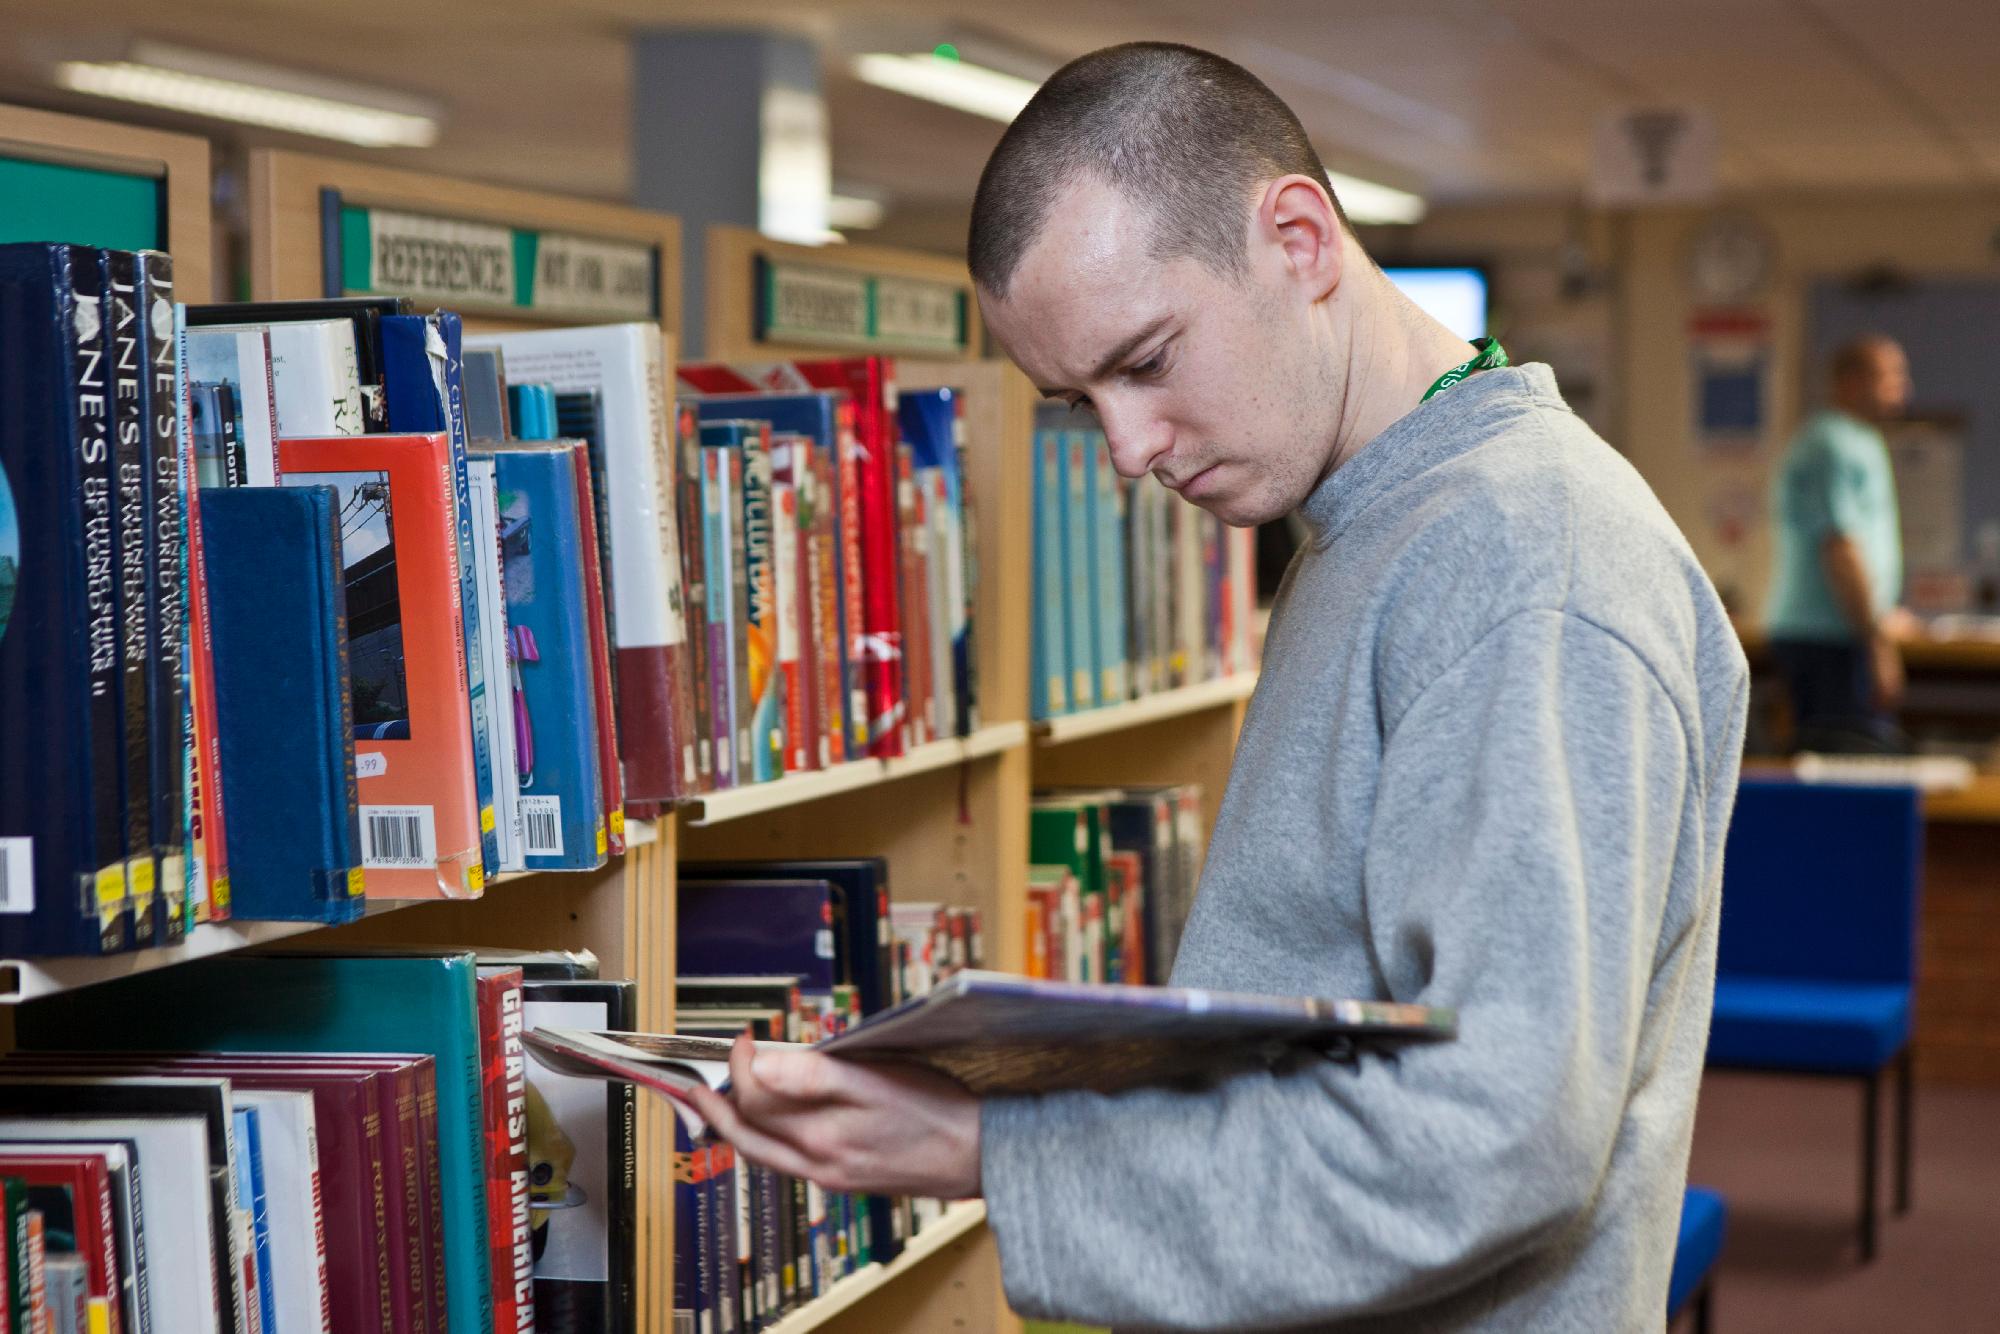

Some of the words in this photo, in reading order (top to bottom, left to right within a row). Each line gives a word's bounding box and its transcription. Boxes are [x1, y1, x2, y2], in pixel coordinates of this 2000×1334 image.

[378, 233, 506, 294] REFERENCE
[72, 288, 106, 464] JANE'S
[111, 282, 140, 446] JANE'S
[150, 274, 176, 438] JANE'S
[180, 331, 189, 405] HURRICANE
[450, 357, 459, 372] A
[225, 422, 233, 434] a
[451, 385, 468, 507] CENTURY
[84, 477, 99, 509] OF
[120, 463, 132, 497] OF
[157, 456, 170, 488] OF
[442, 464, 451, 500] RAPID
[95, 478, 113, 594] FIGHTING
[130, 464, 145, 584] FIGHTING
[157, 495, 172, 587] WORLD
[168, 458, 181, 577] FIGHTING
[194, 518, 203, 545] THE
[446, 504, 455, 552] TRANSIT
[461, 520, 472, 552] OF
[86, 517, 102, 610] WORLD
[120, 503, 135, 598] WORLD
[196, 551, 206, 581] NEW
[449, 555, 461, 608] SYSTEMS
[90, 617, 105, 673] WAR
[100, 603, 115, 668] SHIPS
[124, 602, 138, 659] WAR
[134, 592, 147, 661] SHIPS
[160, 595, 174, 648] WAR
[200, 587, 211, 651] CENTURY
[464, 565, 481, 677] MANNED
[502, 987, 528, 1156] GREATEST
[623, 1101, 634, 1188] Convertibles
[100, 1190, 113, 1232] FIAT
[131, 1165, 143, 1229] Classic
[311, 1170, 327, 1258] BRITISH
[372, 1160, 386, 1246] FORD'S
[403, 1147, 418, 1228] FAMOUS
[103, 1235, 117, 1300] PUNTO
[135, 1233, 145, 1265] Car
[409, 1236, 421, 1293] FORD
[510, 1170, 534, 1334] AMERICA
